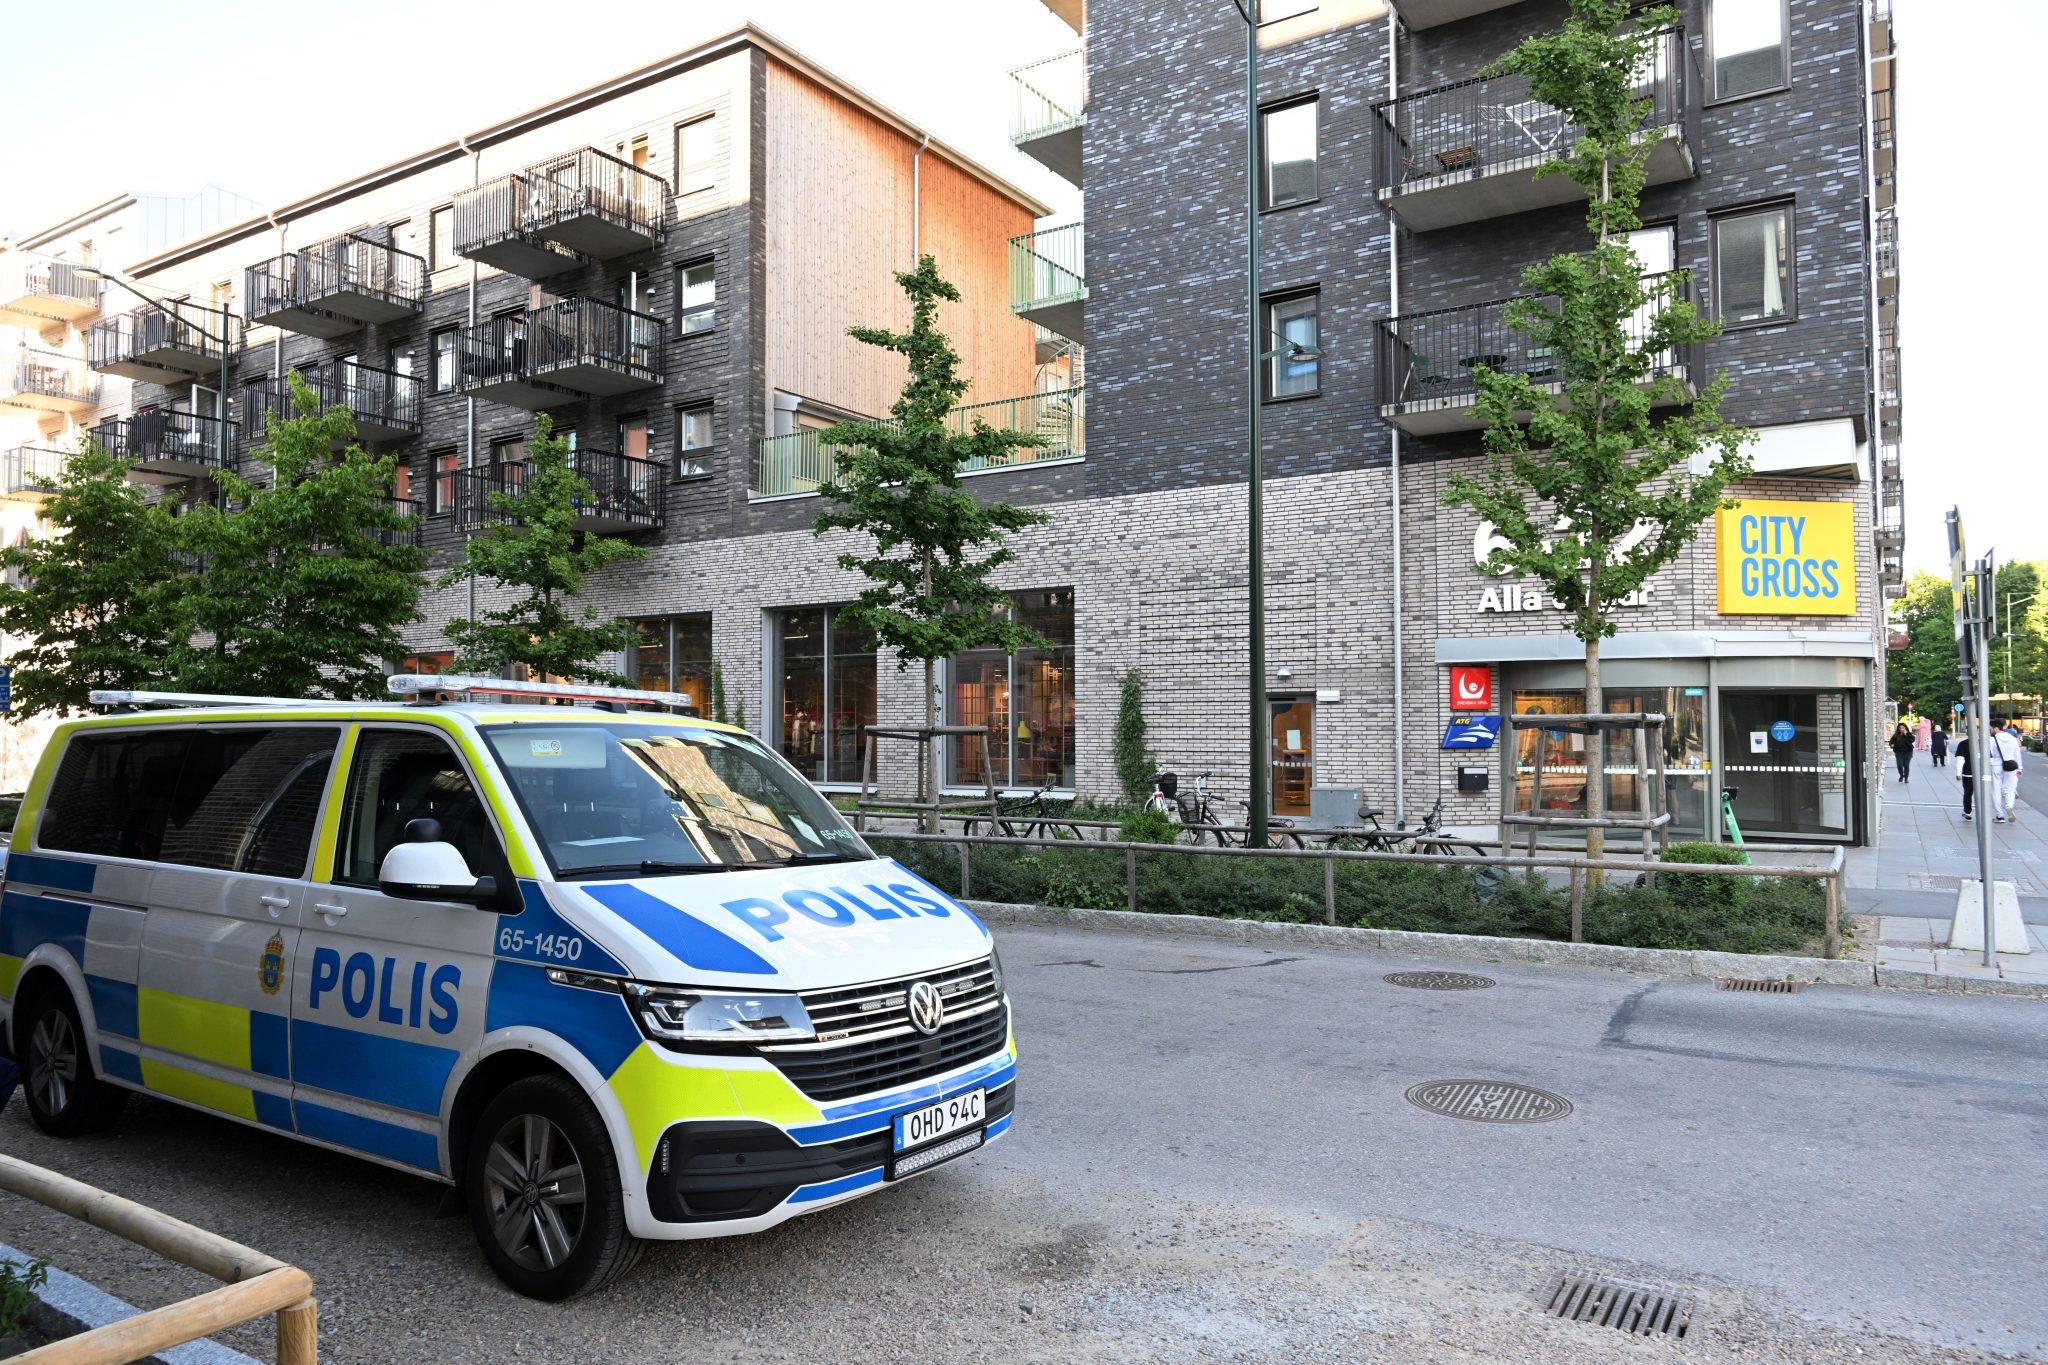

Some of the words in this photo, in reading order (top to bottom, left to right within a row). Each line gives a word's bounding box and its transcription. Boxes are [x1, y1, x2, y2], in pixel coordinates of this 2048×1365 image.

[1740, 514, 1806, 555] CITY
[1477, 583, 1542, 613] Alla
[1741, 557, 1839, 598] GROSS
[720, 883, 951, 943] POLIS
[499, 927, 583, 961] 65-1450
[309, 946, 462, 1035] POLIS
[910, 1106, 944, 1141] OHD
[949, 1094, 979, 1127] 94C
